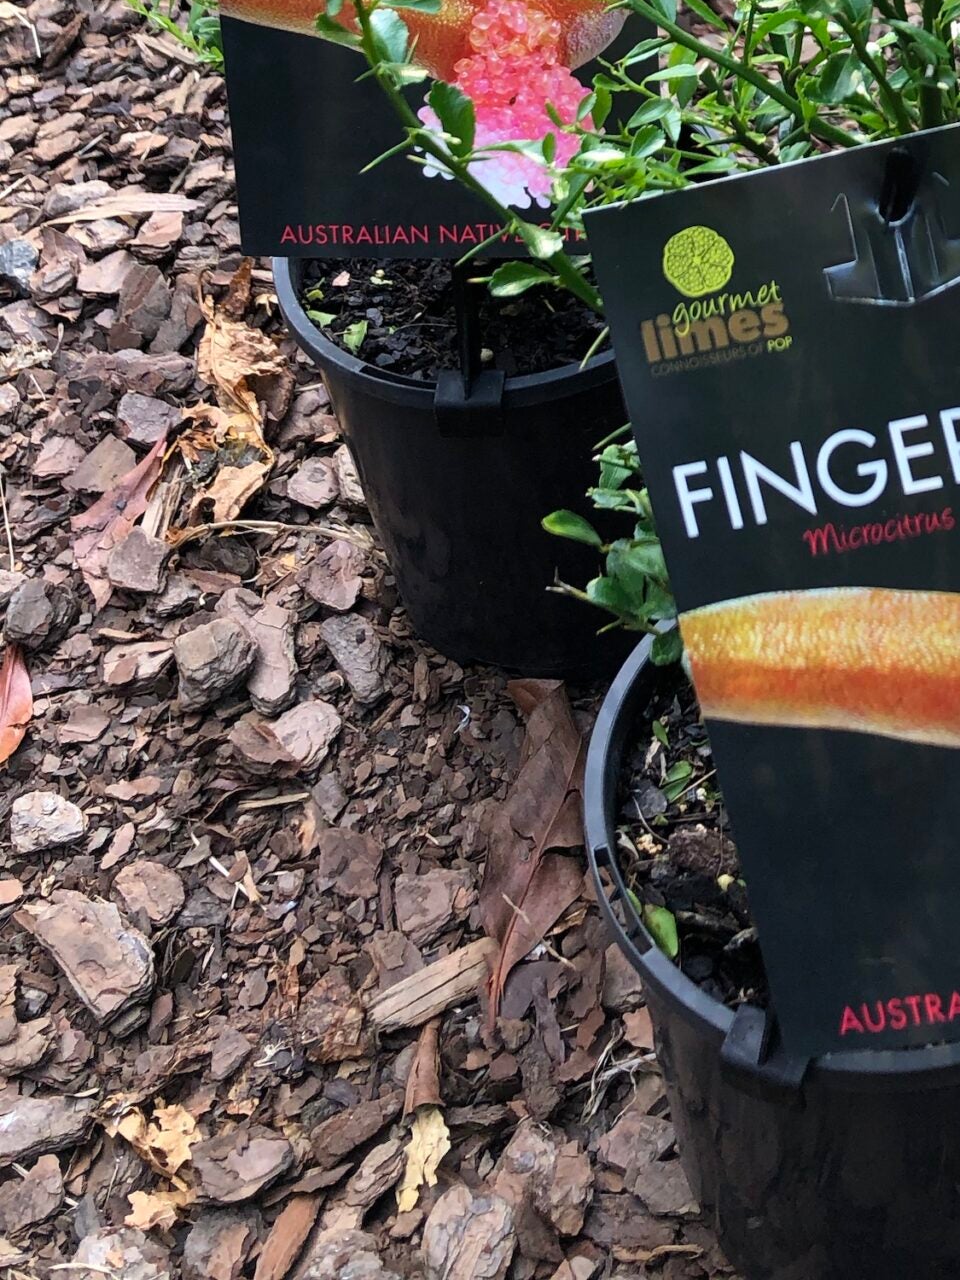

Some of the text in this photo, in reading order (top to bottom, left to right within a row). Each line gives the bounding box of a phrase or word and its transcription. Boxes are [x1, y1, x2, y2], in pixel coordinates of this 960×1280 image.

[280, 224, 429, 245] AUSTRALIAN
[641, 302, 789, 363] limes
[672, 279, 782, 337] gourmet
[767, 335, 793, 353] POP
[803, 506, 955, 556] Microcitrus
